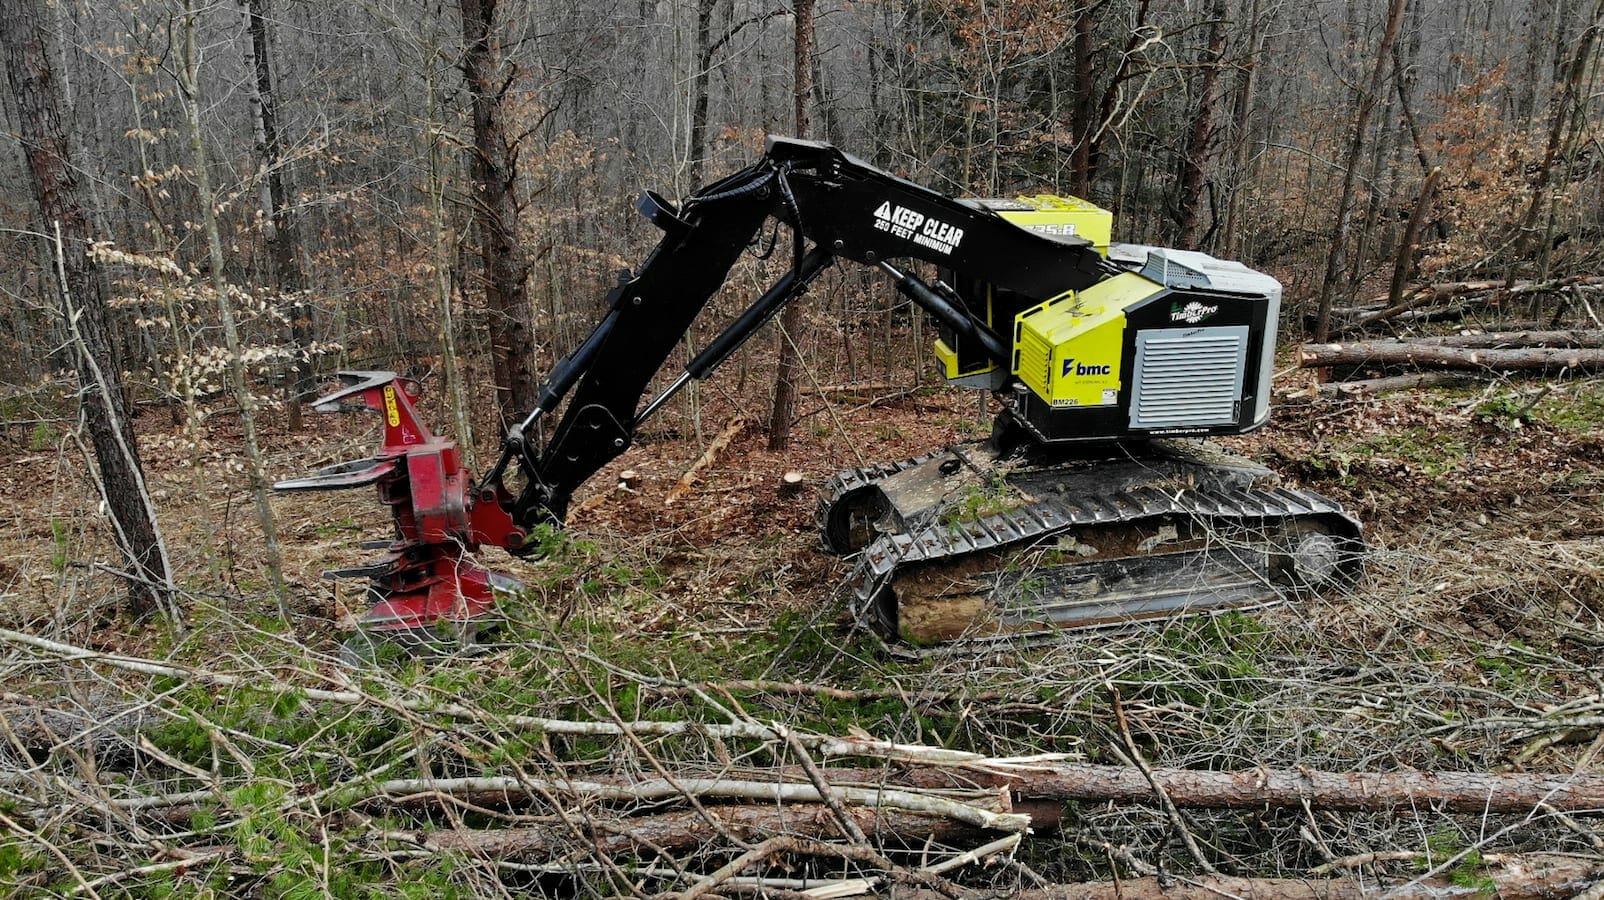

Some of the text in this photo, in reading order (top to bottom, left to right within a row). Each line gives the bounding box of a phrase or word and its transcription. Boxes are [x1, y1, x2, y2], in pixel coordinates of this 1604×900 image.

[874, 219, 953, 255] 250 FEET MINIMUM
[891, 205, 964, 247] KEEP CLEAR
[1171, 305, 1218, 320] TimberPro
[1076, 362, 1111, 376] bmc
